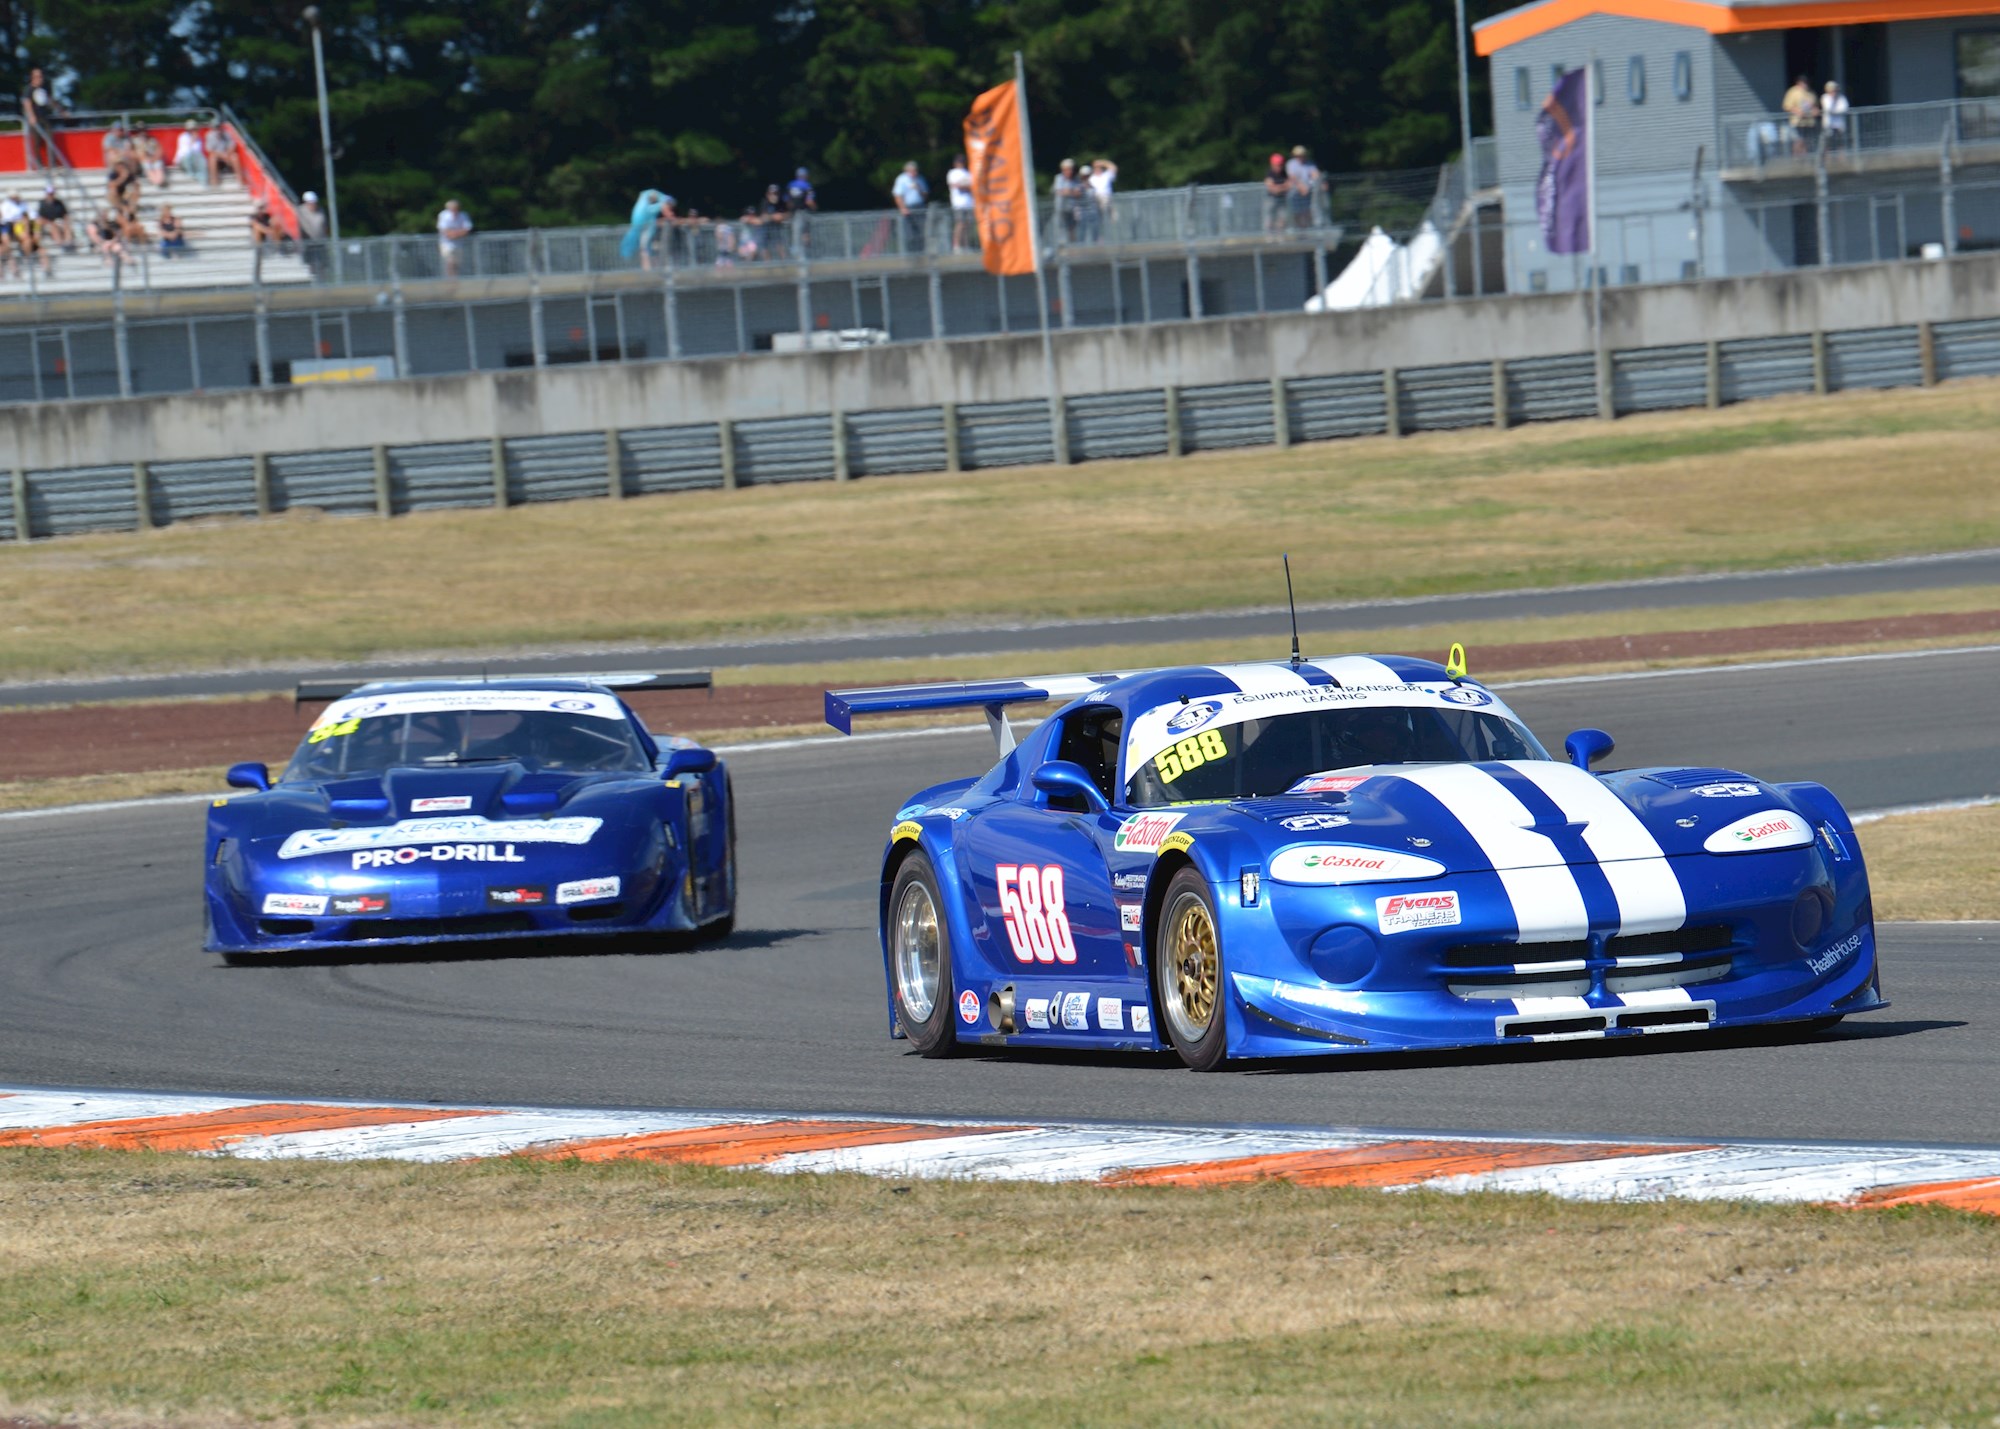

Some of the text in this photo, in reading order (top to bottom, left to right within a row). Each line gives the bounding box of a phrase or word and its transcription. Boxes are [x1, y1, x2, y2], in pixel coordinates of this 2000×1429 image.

[1233, 684, 1424, 704] EQUIPMENT & TRANSPORT
[1302, 692, 1368, 704] LEASING
[1153, 728, 1228, 785] 588
[393, 821, 487, 834] KERRY
[896, 824, 920, 835] DUNLOP
[1126, 816, 1178, 847] Castrol
[1748, 819, 1793, 838] Castrol
[1162, 835, 1190, 847] DUNLOP
[351, 843, 526, 871] PRO-DRILL
[1322, 855, 1387, 870] Castrol
[995, 863, 1078, 965] 588
[1383, 896, 1455, 917] Evans
[1384, 910, 1456, 926] TRAILERS
[1806, 934, 1862, 976] HealthHouse
